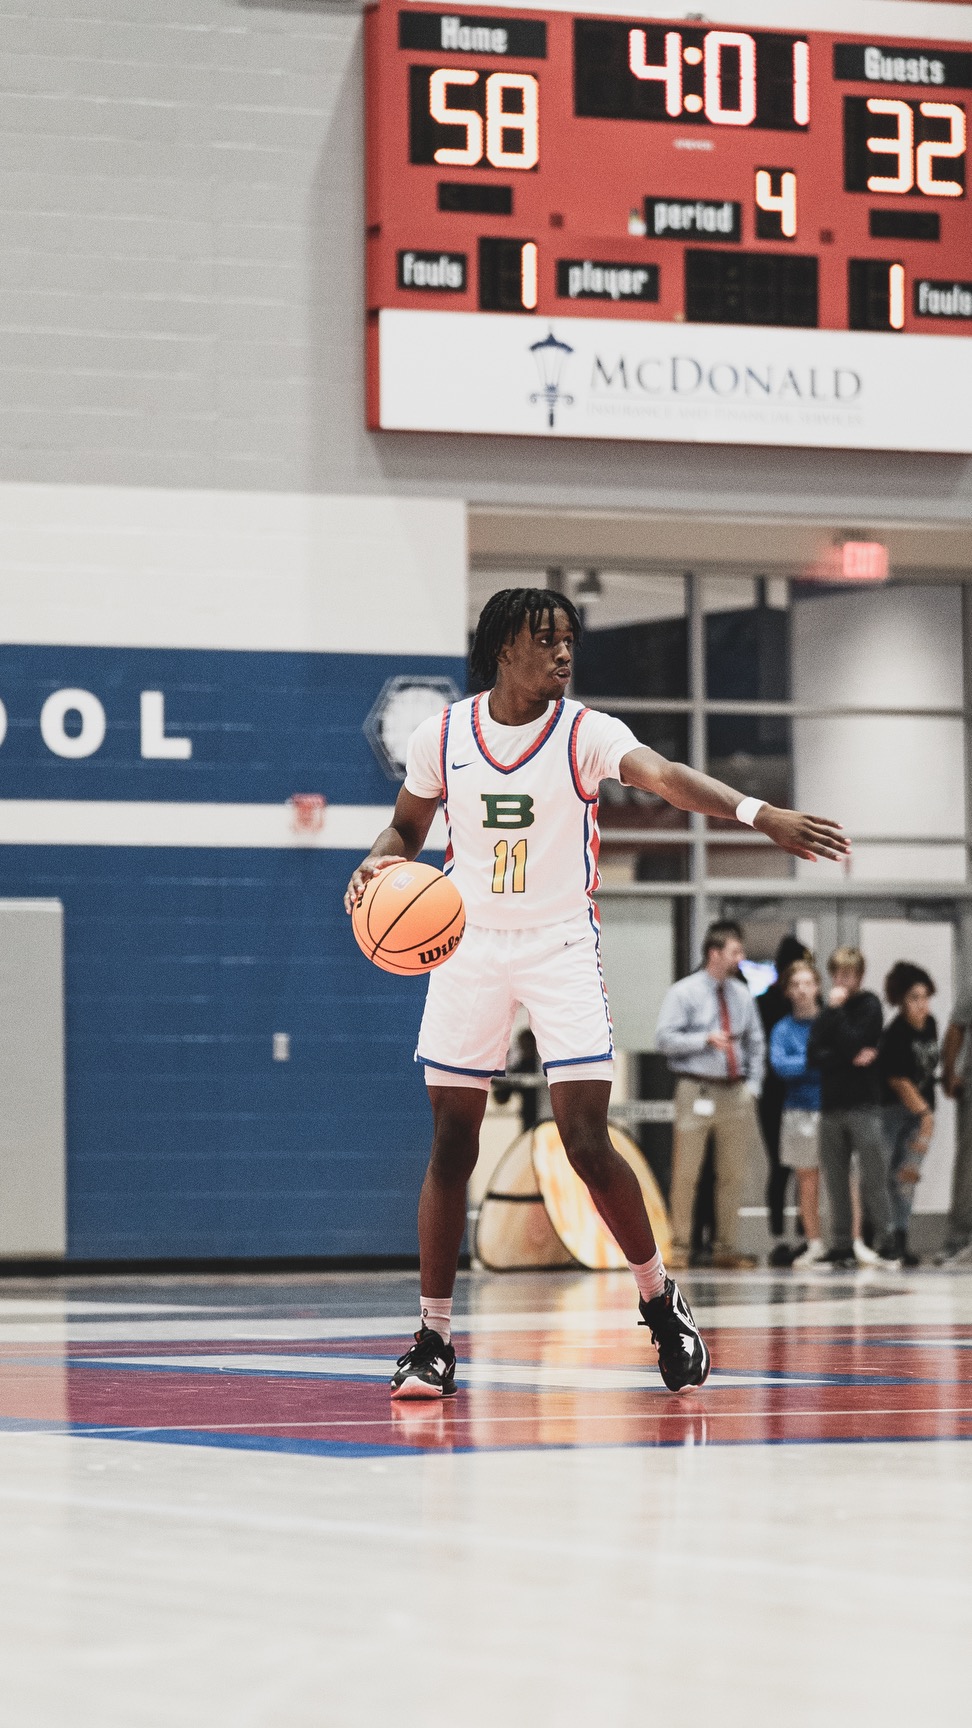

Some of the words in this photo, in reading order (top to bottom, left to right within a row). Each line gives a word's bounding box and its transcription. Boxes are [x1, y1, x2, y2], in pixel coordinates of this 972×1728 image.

[441, 16, 507, 53] Home
[628, 28, 810, 126] 4:01
[864, 46, 945, 84] Guests
[429, 68, 539, 170] 58
[866, 98, 967, 196] 32
[654, 202, 733, 235] period
[755, 170, 796, 237] 4
[403, 252, 463, 288] fouls
[568, 260, 648, 299] player
[481, 793, 534, 829] B
[490, 839, 528, 894] 11
